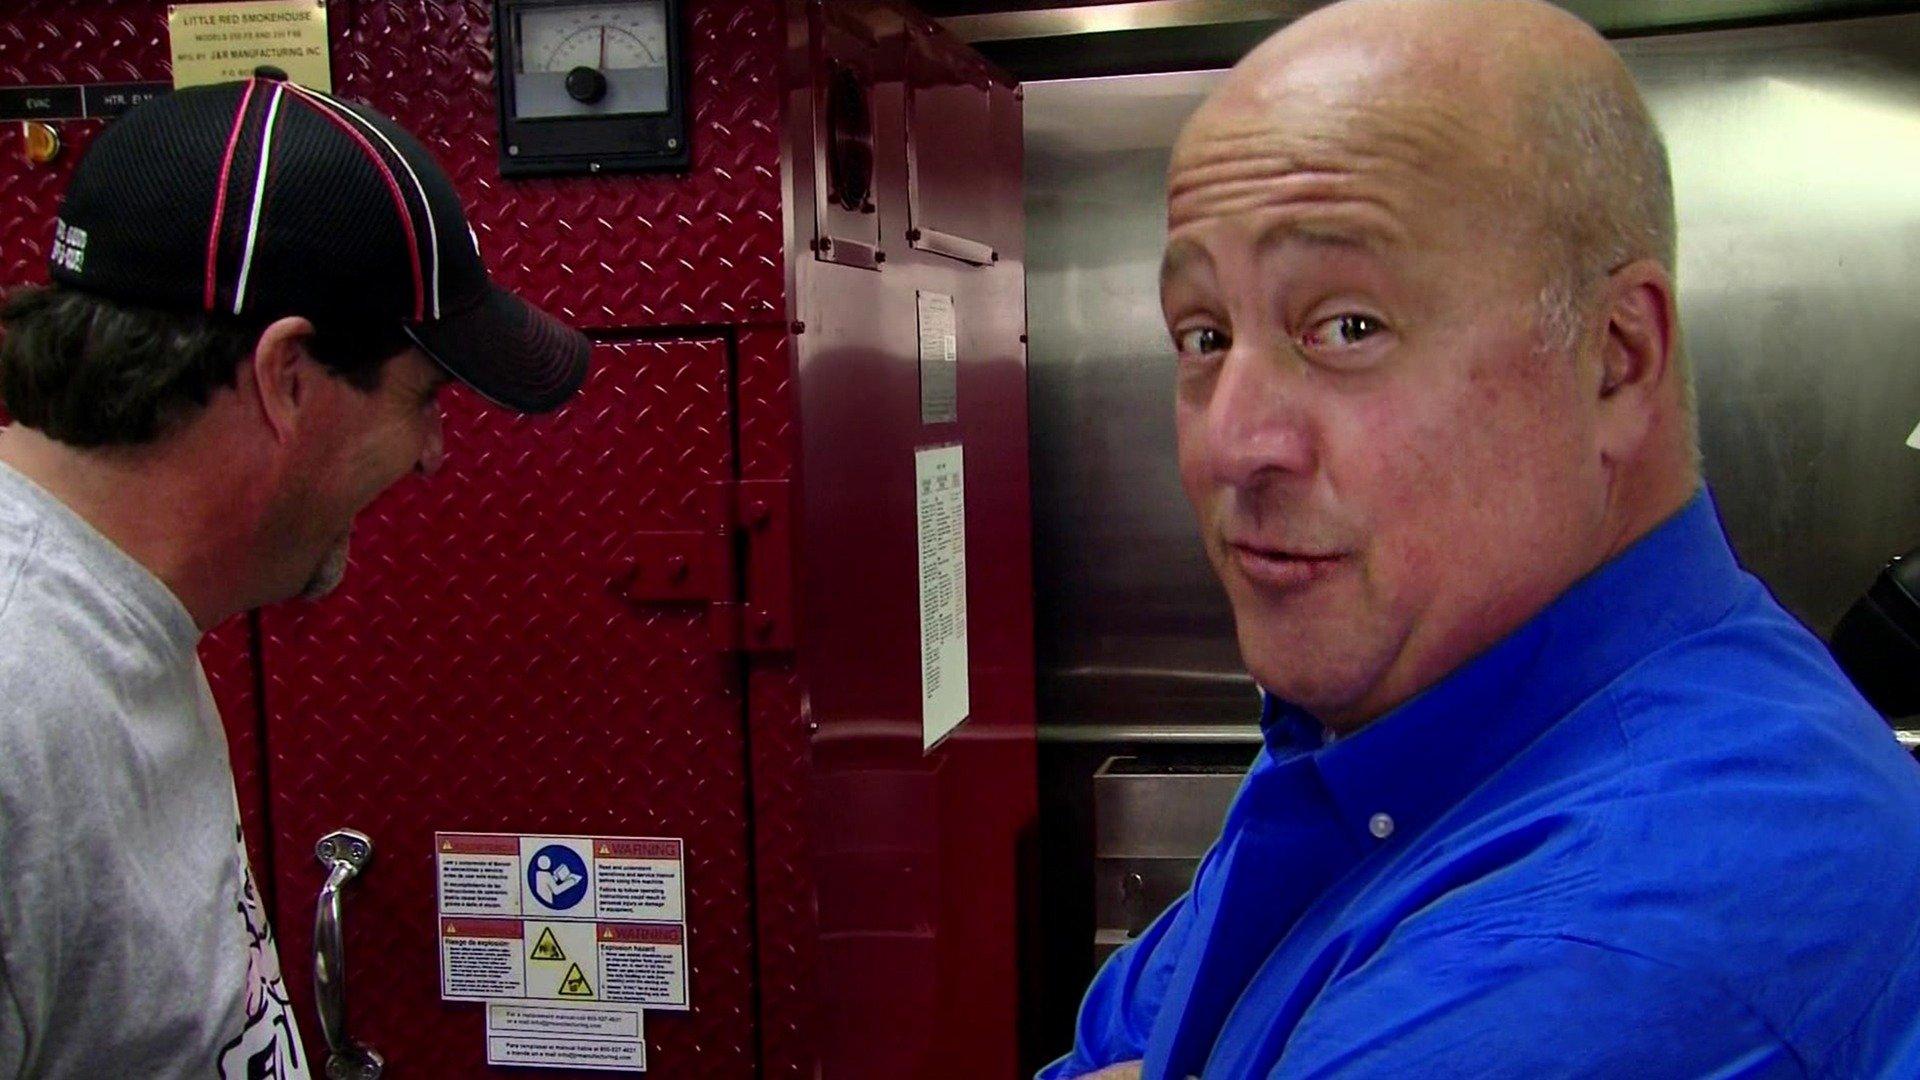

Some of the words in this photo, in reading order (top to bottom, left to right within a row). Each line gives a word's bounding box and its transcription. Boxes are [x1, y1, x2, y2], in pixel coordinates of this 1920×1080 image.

[183, 14, 215, 26] LITTLE
[218, 14, 240, 24] RED
[241, 11, 312, 23] SMOKEHOUSE
[211, 50, 230, 60] J&R
[26, 98, 51, 109] EVAC
[611, 843, 676, 856] WARNING
